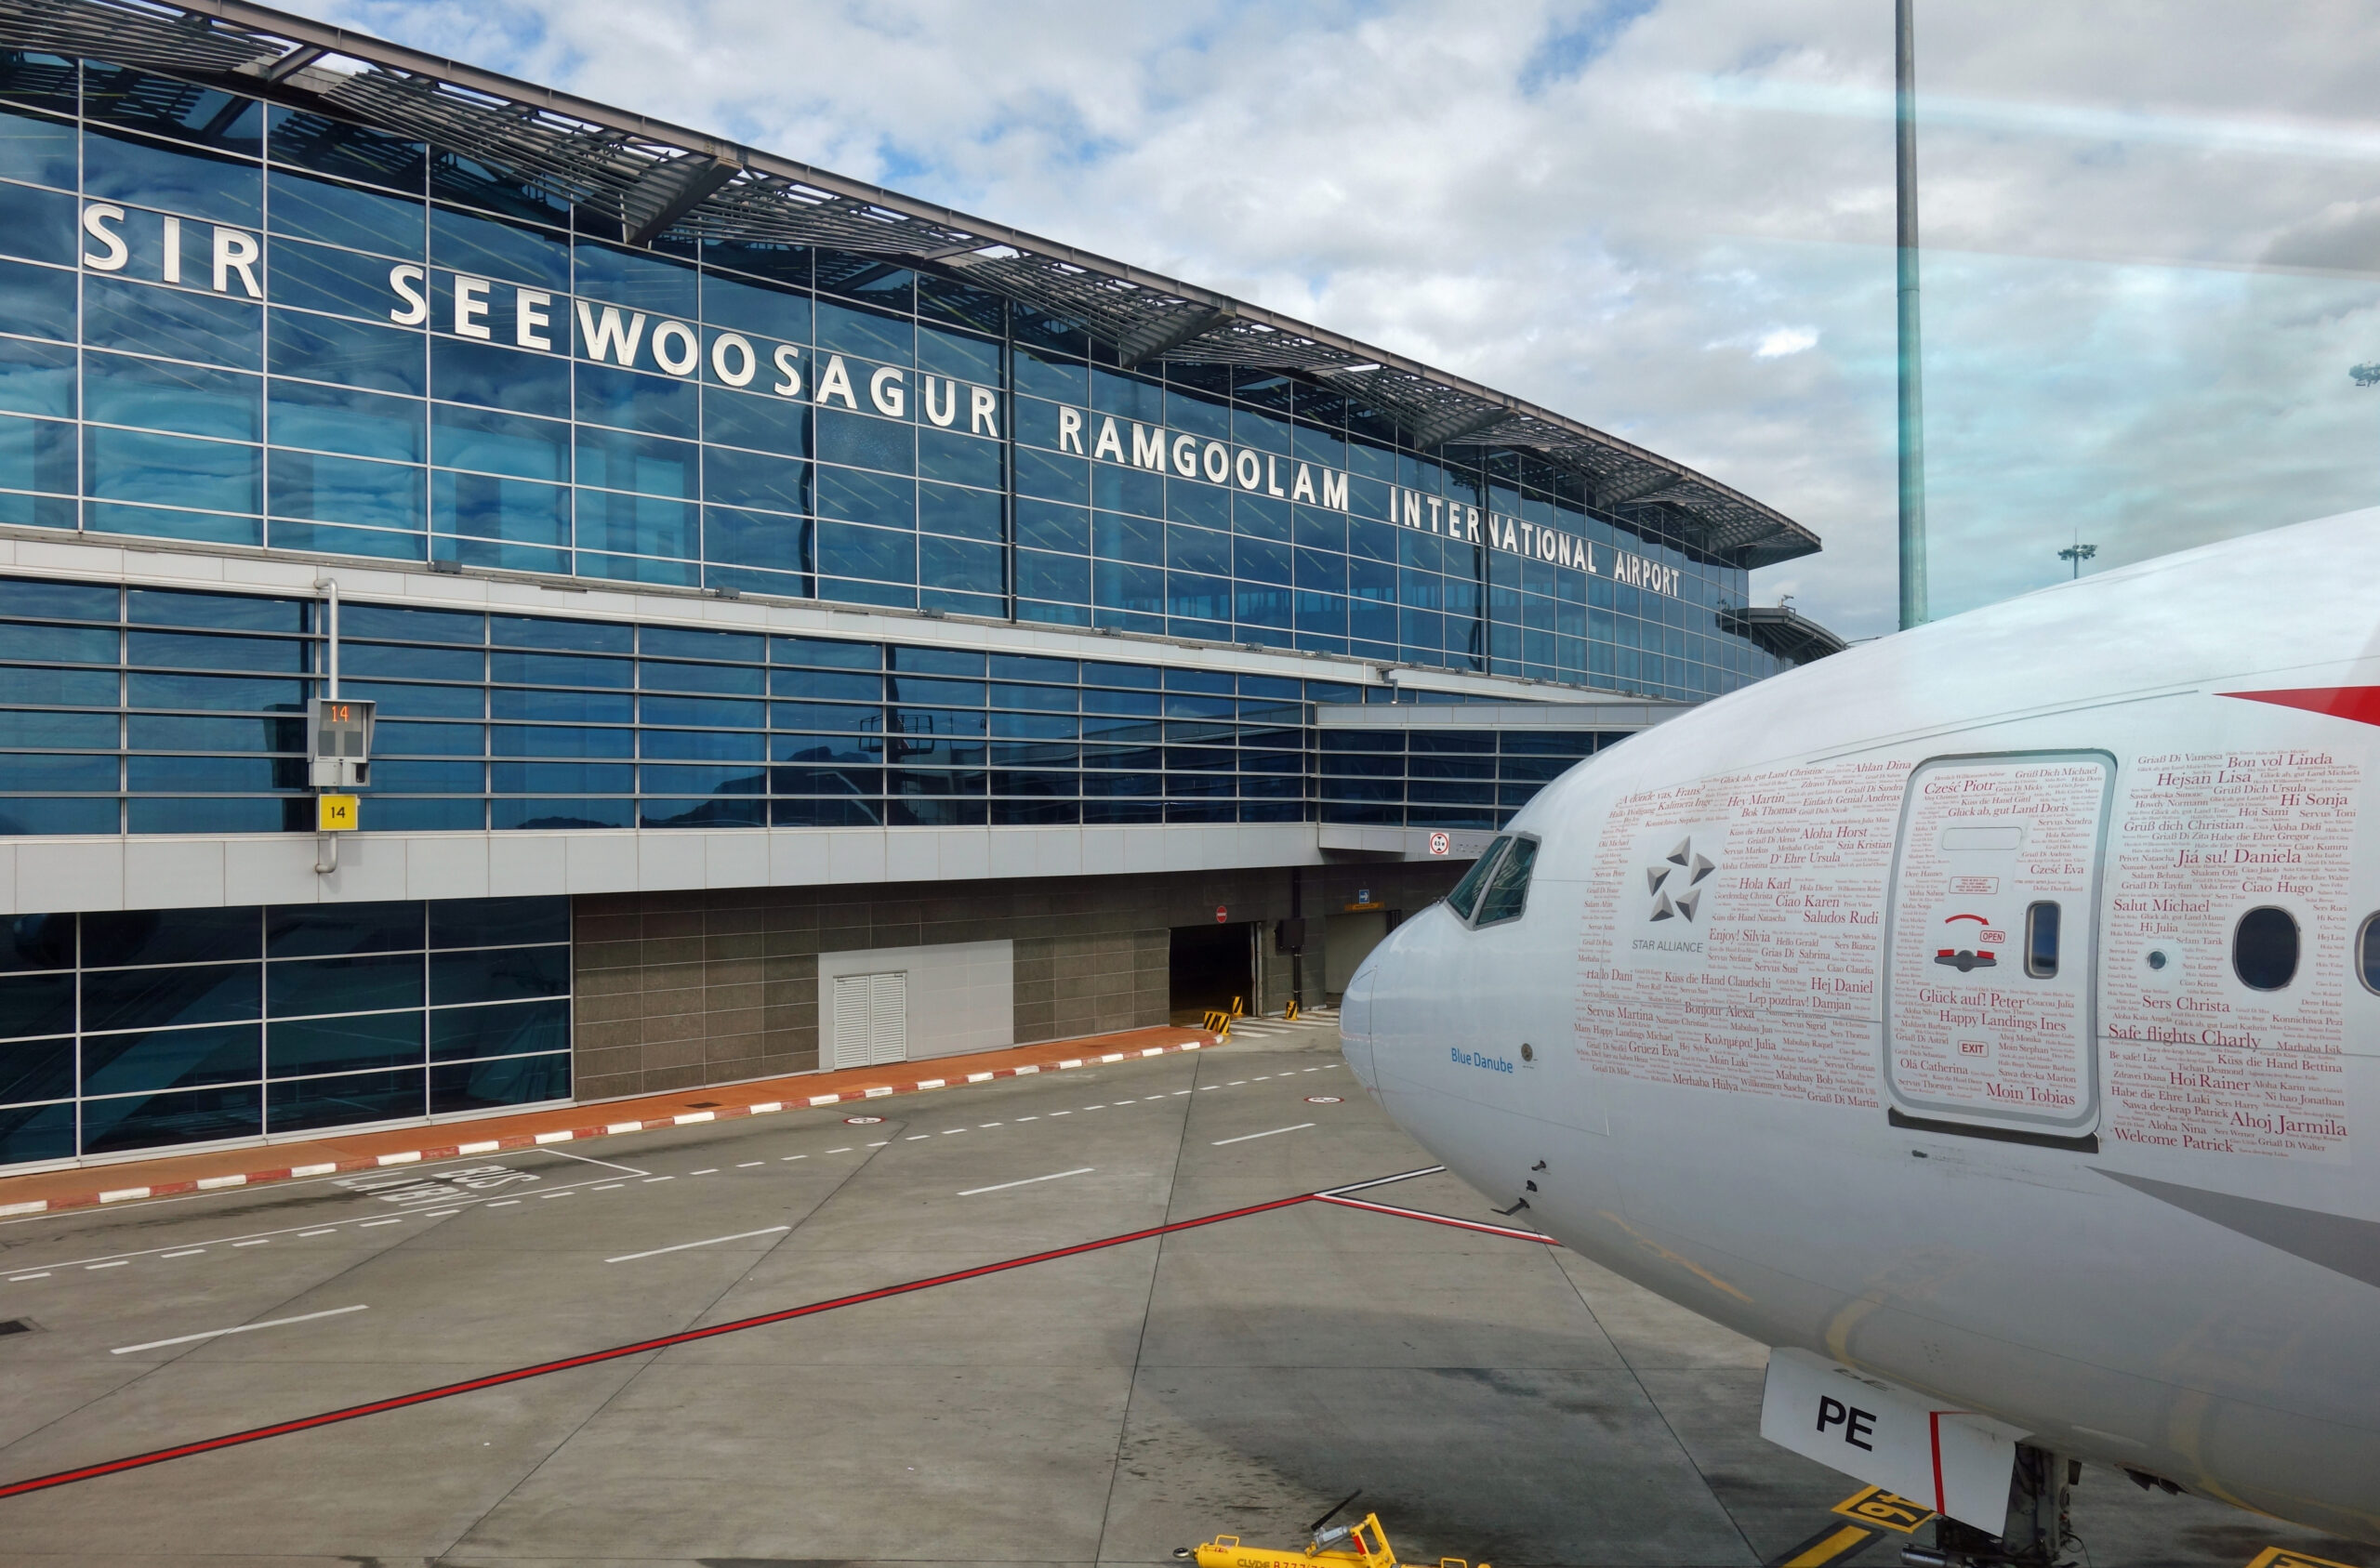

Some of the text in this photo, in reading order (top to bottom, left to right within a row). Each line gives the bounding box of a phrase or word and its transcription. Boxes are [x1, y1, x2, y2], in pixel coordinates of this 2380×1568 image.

[83, 204, 1680, 597] SIR SEEWOOSAGUR RAMGOOLAM INTERNATIONAL AIRPORT
[331, 705, 350, 722] 14
[1852, 760, 1911, 772] Ahlan Dina
[2227, 753, 2333, 768] Bon vol Linda
[2039, 769, 2060, 777] Dich
[2061, 767, 2097, 776] Michael
[2157, 770, 2251, 789] Hejsan Lisa
[1964, 780, 1995, 792] Piotr
[2244, 784, 2268, 794] Dich
[2272, 784, 2307, 793] Ursula
[1727, 792, 1785, 809] Hey Martin
[1803, 793, 1900, 807] Einfach Genial Andreas
[2281, 793, 2347, 808] Hi Sonja
[330, 806, 346, 819] 14
[1741, 806, 1797, 817] Bok Thomas
[1992, 807, 2010, 817] gut
[2011, 804, 2039, 814] Land
[2041, 802, 2069, 813] Doris
[2334, 809, 2356, 817] Toni
[1800, 826, 1868, 839] Aloha Horst
[2158, 820, 2183, 831] dich
[2188, 819, 2243, 830] Christian
[1837, 840, 1892, 850] Szia Kristian
[1784, 853, 1806, 863] Ehre
[1809, 851, 1840, 863] Ursula
[2204, 850, 2228, 863] su!
[2234, 849, 2301, 863] Daniela
[2064, 863, 2083, 875] Eva
[1739, 877, 1792, 889] Hola Karl
[2241, 881, 2314, 895] Ciao Hugo
[1776, 894, 1839, 907] Ciao Karen
[2113, 899, 2209, 912] Salut Michael
[1803, 910, 1879, 924] Saludos Rudi
[2140, 922, 2178, 934] Hi Julia
[1709, 928, 1770, 945] Enjoy! Silvia
[1983, 932, 2003, 941] OPEN
[1632, 940, 1703, 953] STAR ALLIANCE
[1834, 941, 1875, 951] Sers Bianca
[1784, 948, 1794, 957] Di
[1799, 949, 1831, 960] Sabrina
[1586, 967, 1633, 982] Hallo Dani
[1754, 962, 1798, 973] Servus Susi
[1827, 964, 1874, 975] Ciao Claudia
[1686, 973, 1699, 984] die
[1701, 973, 1726, 985] Hand
[1727, 975, 1771, 989] Claudschi
[1811, 977, 1873, 995] Hej Daniel
[1749, 992, 1851, 1013] Lep pozdrav! Damjan
[1919, 989, 2025, 1008] Glück auf! Peter
[2142, 995, 2230, 1012] Sers Christa
[1587, 1004, 1654, 1021] Servus Martina
[1685, 1001, 1755, 1019] Bonjour Alexa
[1781, 1019, 1827, 1031] Servus Sigrid
[1939, 1009, 2066, 1032] Happy Landings Ines
[1646, 1030, 1673, 1042] Michael
[2108, 1024, 2263, 1053] Safe flights Charly
[1629, 1041, 1679, 1058] Grüezi Eva
[1753, 1037, 1777, 1052] Julia
[1962, 1043, 1984, 1054] EXIT
[1451, 1048, 1514, 1074] Blue Danube
[1920, 1060, 1968, 1074] Catherina
[2246, 1057, 2262, 1067] die
[2267, 1058, 2298, 1070] Hand
[2302, 1060, 2343, 1073] Bettina
[1673, 1073, 1710, 1087] Merhaba
[1740, 1076, 1806, 1093] Willkommen Sascha
[1776, 1069, 1833, 1086] Mabuhay Bob
[2170, 1072, 2196, 1087] Hoi
[2200, 1074, 2251, 1091] Rainer
[1807, 1091, 1879, 1108] Griaß Di Martin
[1986, 1082, 2075, 1105] Moin Tobias
[2111, 1086, 2210, 1104] Habe die Ehre Luki
[2229, 1112, 2347, 1137] Ahoj Jarmila
[2114, 1126, 2234, 1153] Welcome Patrick
[431, 1165, 541, 1189] BUS
[1817, 1395, 1877, 1452] PE
